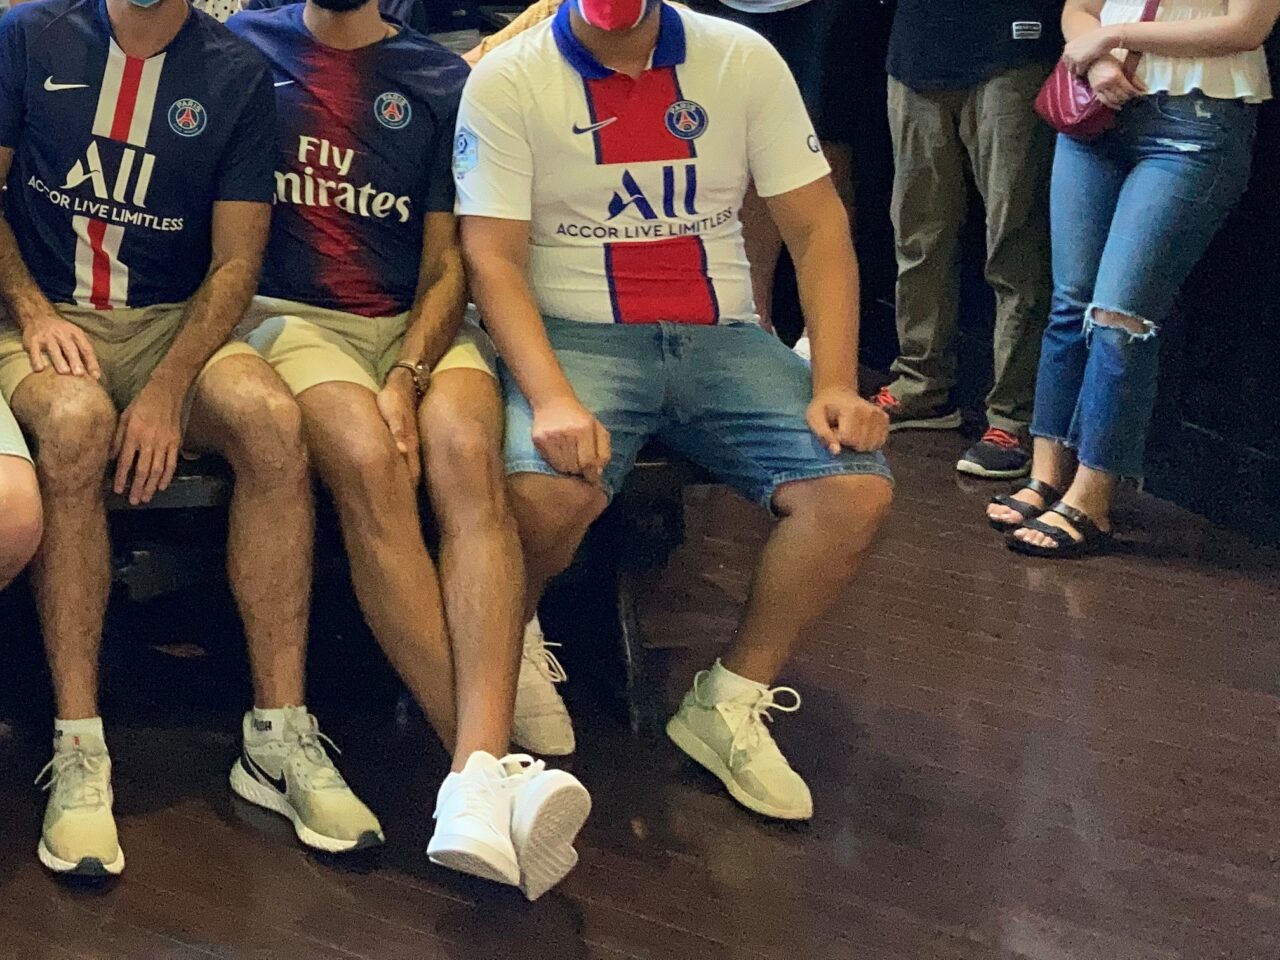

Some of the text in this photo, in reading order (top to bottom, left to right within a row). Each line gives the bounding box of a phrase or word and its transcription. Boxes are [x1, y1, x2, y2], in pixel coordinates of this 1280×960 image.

[297, 134, 354, 176] Fly
[273, 166, 411, 223] mirates
[73, 197, 109, 219] LIVE
[111, 207, 184, 232] LIMITLESS
[555, 205, 734, 240] ACCOR LIVE LIMITLESS
